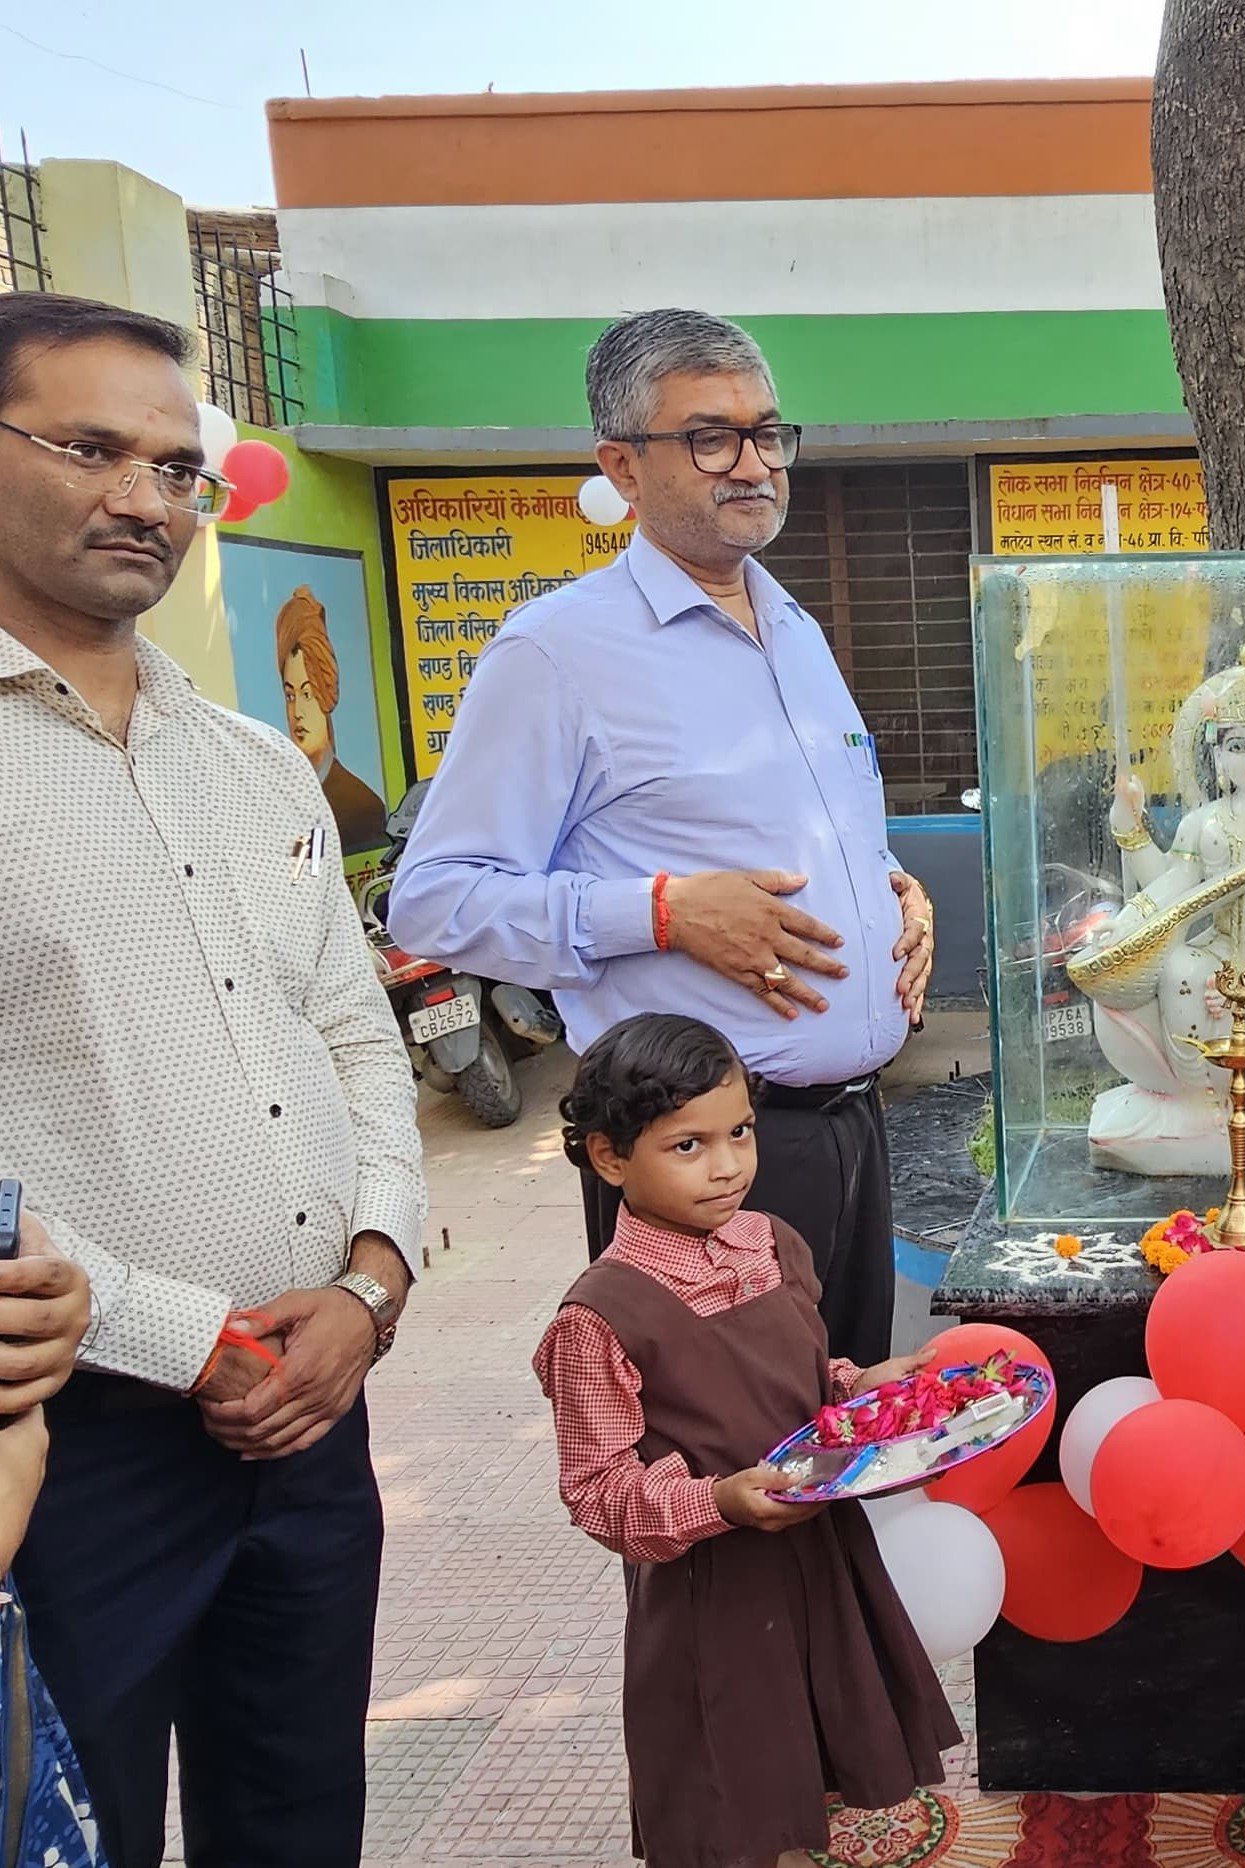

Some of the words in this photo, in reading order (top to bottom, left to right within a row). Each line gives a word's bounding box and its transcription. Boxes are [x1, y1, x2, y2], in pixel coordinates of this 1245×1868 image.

[998, 470, 1031, 496] लोक
[1034, 475, 1068, 495] सभा
[394, 489, 506, 524] अधिकारियों
[997, 499, 1037, 523] विधान
[1041, 503, 1071, 524] सभा
[408, 527, 512, 561] जिलाधिकारी
[1038, 535, 1064, 551] स्थल
[453, 572, 505, 605] विकास
[416, 615, 456, 647] जिला
[418, 657, 453, 682] खण्ड
[422, 694, 455, 721] खण्ड
[420, 1010, 475, 1038] CB4572
[428, 999, 464, 1022] DL7S
